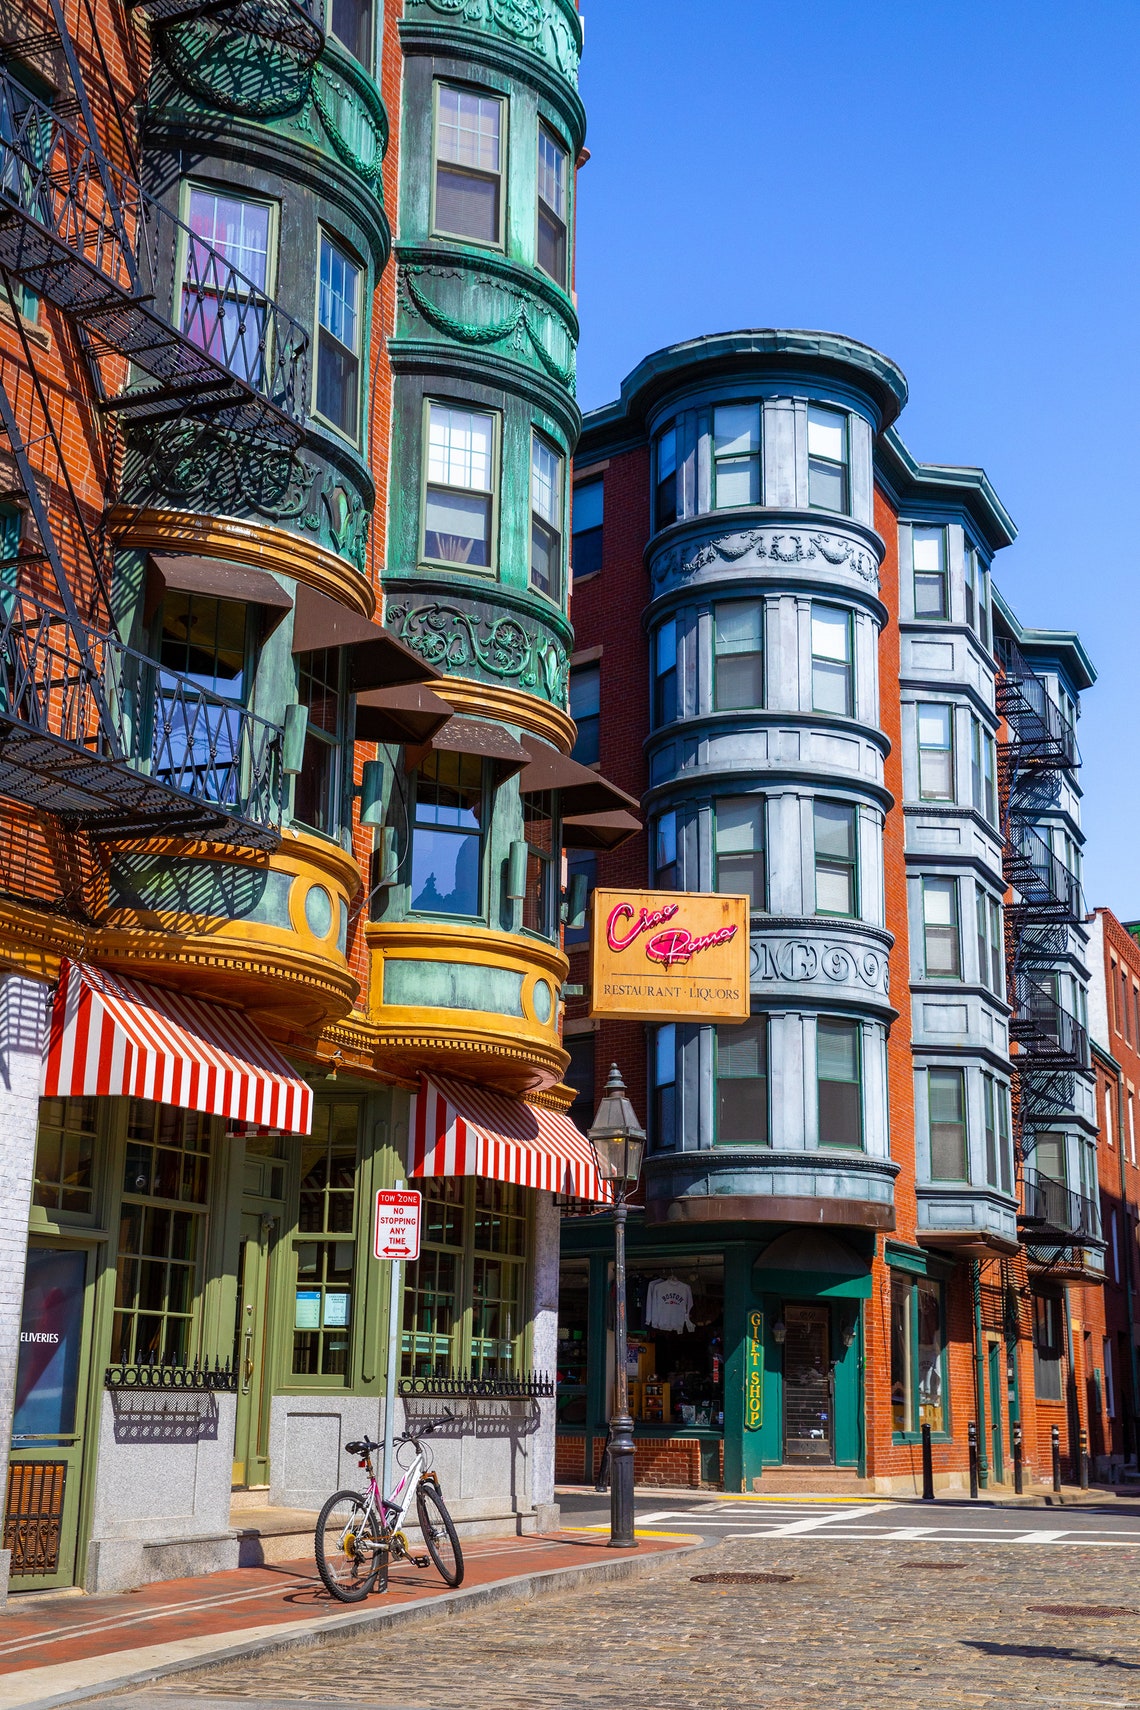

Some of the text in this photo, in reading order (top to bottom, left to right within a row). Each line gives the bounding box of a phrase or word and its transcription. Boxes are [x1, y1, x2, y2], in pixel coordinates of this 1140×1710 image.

[607, 902, 678, 951] Ciao
[647, 924, 738, 964] Roma
[604, 984, 740, 1001] RESTAURANT LIQUORS
[381, 1194, 418, 1203] TOW ZONE
[393, 1207, 404, 1215] NO
[380, 1217, 416, 1225] STOPPING
[389, 1227, 406, 1235] ANY
[389, 1237, 406, 1245] TIME
[20, 1332, 59, 1343] ELIVERIES
[749, 1313, 761, 1425] GIFT SHOP
